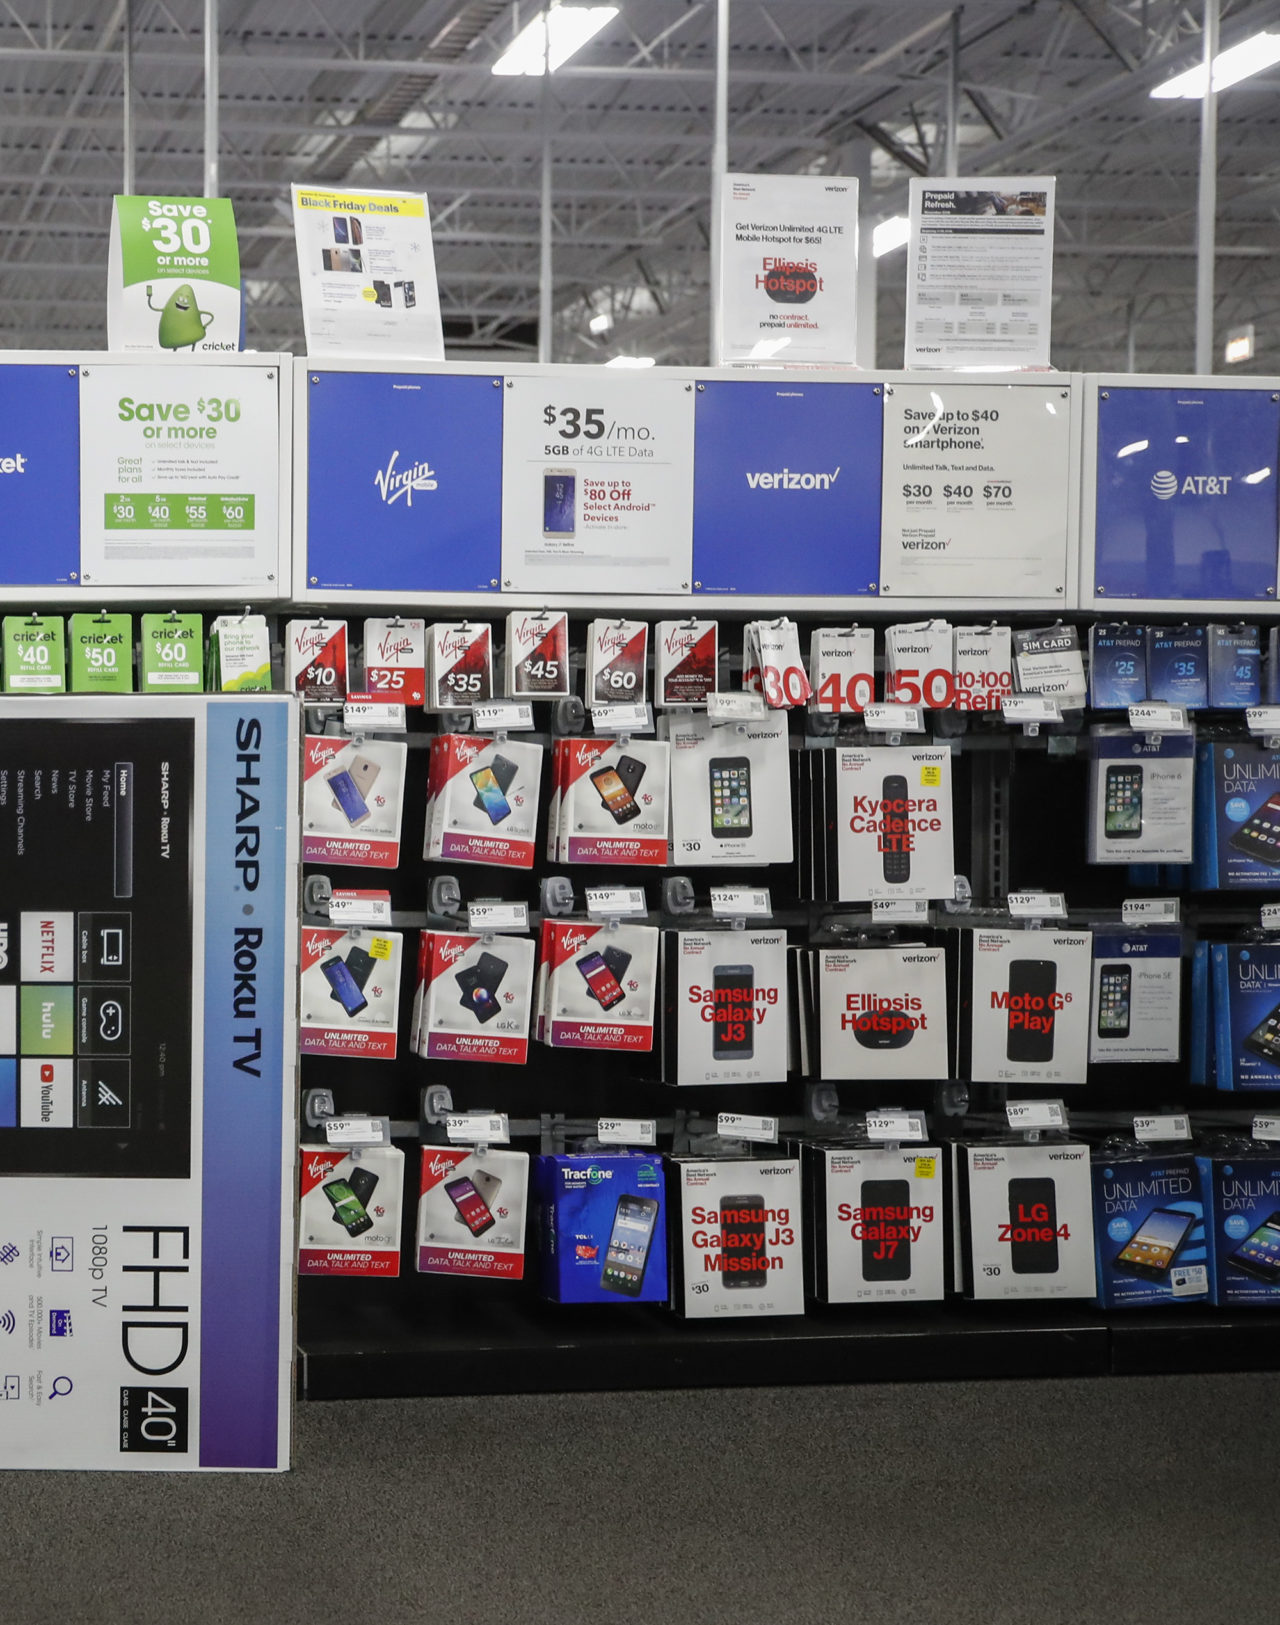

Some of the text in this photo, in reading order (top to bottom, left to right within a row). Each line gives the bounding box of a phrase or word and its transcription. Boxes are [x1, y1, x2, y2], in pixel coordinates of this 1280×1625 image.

[925, 191, 955, 200] Prepaid
[148, 200, 207, 218] Save
[301, 197, 399, 214] Black Friday Deals
[735, 223, 749, 231] Get
[750, 224, 778, 232] Verizon
[779, 224, 814, 233] Unlimited
[829, 226, 844, 234] LTE
[735, 234, 760, 242] Mobile
[761, 235, 791, 244] Hotspot
[804, 236, 822, 245] $65!
[157, 256, 208, 266] or more
[762, 257, 818, 275] Ellipsis
[755, 274, 824, 294] Hotspot
[202, 341, 235, 352] cricket
[118, 397, 241, 424] Save $30
[904, 408, 999, 423] Save up to $40
[143, 427, 217, 440] or more
[903, 424, 980, 435] on Verizon
[544, 445, 654, 458] 5GB of 4G LTE Data
[117, 457, 143, 466] Great
[118, 465, 142, 475] plans
[935, 464, 950, 472] Talk,
[375, 450, 435, 507] Virgin
[583, 479, 631, 490] Save up to
[746, 470, 830, 490] verizon
[1181, 476, 1231, 495] AT&T
[583, 489, 631, 501] $80 Off
[902, 484, 1012, 499] $30 $40 $70
[113, 505, 244, 519] $30 $40 $55 $60
[583, 513, 619, 523] Devices
[902, 540, 946, 551] verizon
[13, 629, 57, 643] cricket
[80, 631, 124, 645] cricket
[151, 628, 194, 639] cricket
[155, 642, 186, 662] $60
[896, 646, 930, 654] verizon
[1022, 638, 1072, 651] SIM CARD
[18, 645, 49, 665] $40
[85, 647, 116, 667] $50
[306, 667, 335, 686] $10
[524, 661, 558, 679] $45
[1115, 661, 1135, 675] $25
[1175, 662, 1195, 676] $35
[370, 670, 404, 689] $25
[447, 673, 481, 693] $35
[602, 670, 636, 688] $60
[34, 769, 42, 801] Search
[120, 769, 128, 797] Home
[17, 769, 25, 856] Streaming Channels
[853, 795, 938, 815] Kyocera
[849, 815, 942, 834] Cadence
[326, 841, 371, 851] UNLIMITED
[468, 838, 510, 850] UNLIMITED
[596, 841, 641, 851] UNLIMITED
[877, 834, 915, 852] LTE
[232, 717, 263, 1078] SHARP Roku TV
[40, 920, 55, 973] NETFLIX
[1131, 944, 1148, 952] AT&T
[688, 985, 779, 1006] Samsung
[845, 993, 922, 1014] Ellipsis
[990, 991, 1043, 1010] Moto
[41, 1002, 55, 1039] hulu
[700, 1004, 767, 1024] Galaxy
[1009, 1010, 1054, 1033] Play
[721, 1023, 747, 1042] J3
[840, 1013, 928, 1034] Hotspot
[455, 1037, 500, 1047] UNLIMITED
[41, 1084, 53, 1123] YouTube
[561, 1167, 613, 1180] Tracfone
[1103, 1177, 1192, 1200] UNLIMITED
[691, 1206, 790, 1226] Samsung
[837, 1203, 934, 1223] Samsung
[1018, 1203, 1049, 1222] LG
[1105, 1200, 1138, 1214] DATA
[691, 1228, 795, 1250] Galaxy J3
[851, 1223, 922, 1242] Galaxy
[998, 1224, 1070, 1242] Zone 4
[326, 1252, 372, 1262] UNLIMITED
[448, 1251, 495, 1262] UNLIMITED
[873, 1241, 898, 1260] J7
[89, 1225, 108, 1308] 1080p TV
[703, 1252, 784, 1272] Mission
[122, 1226, 189, 1376] FHD
